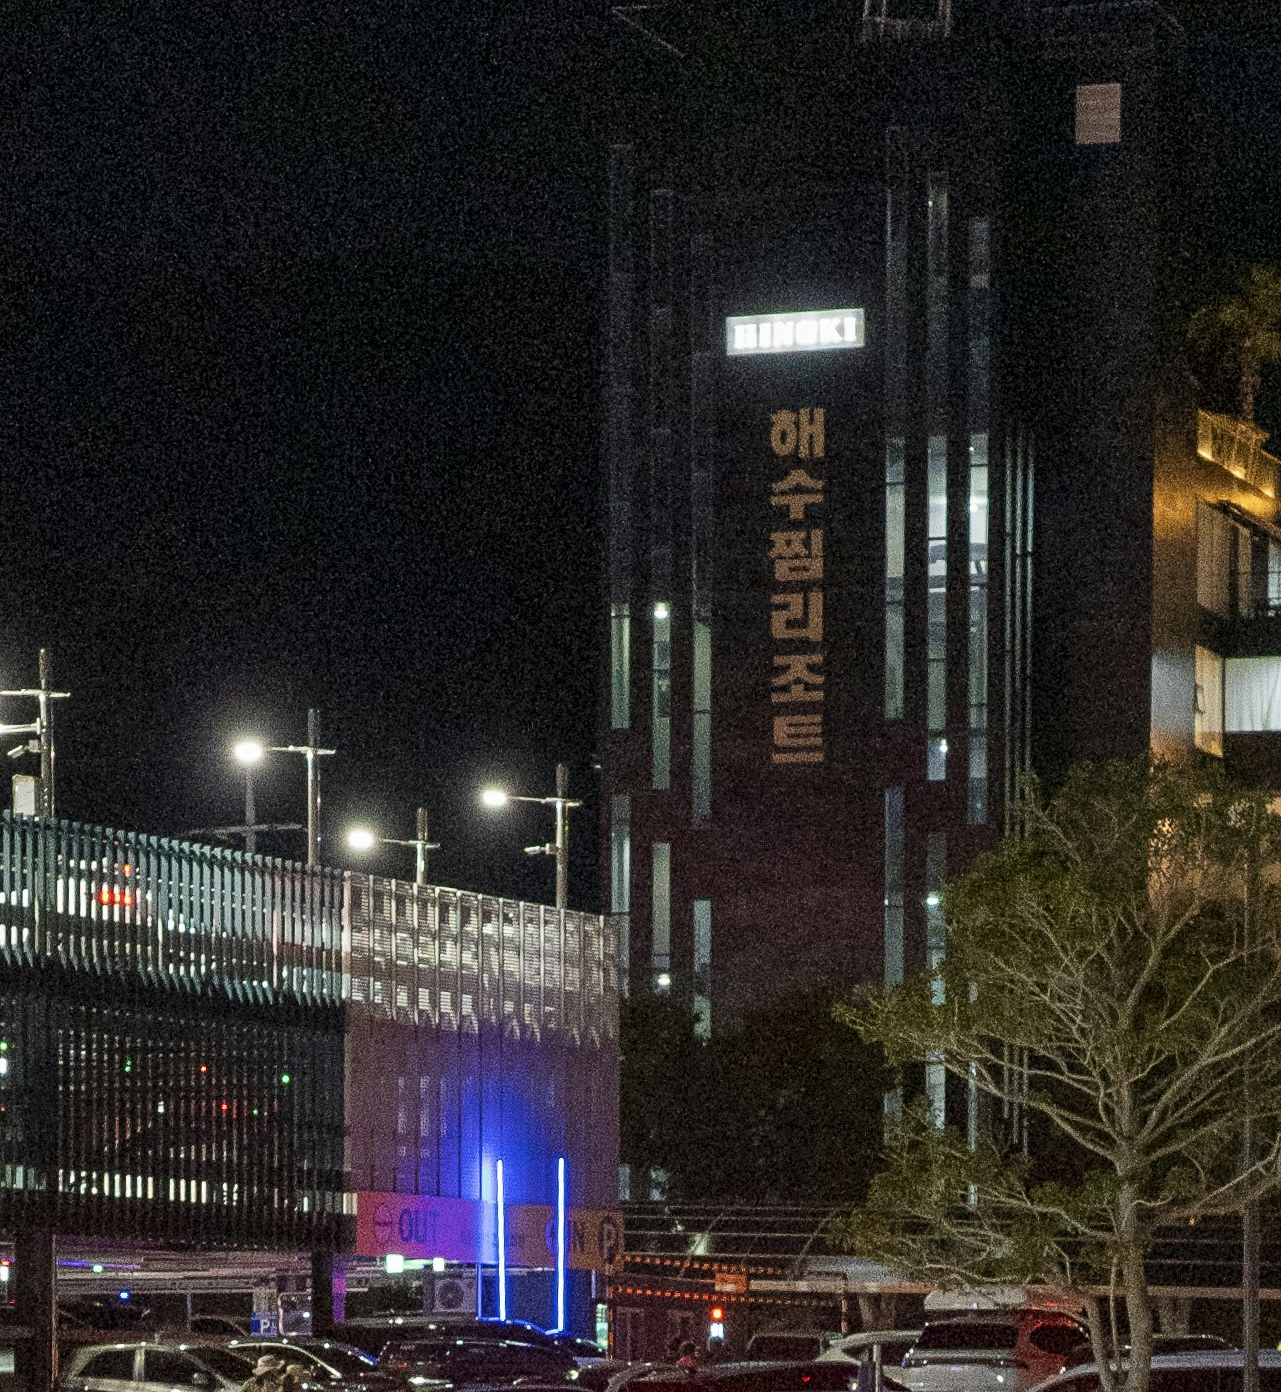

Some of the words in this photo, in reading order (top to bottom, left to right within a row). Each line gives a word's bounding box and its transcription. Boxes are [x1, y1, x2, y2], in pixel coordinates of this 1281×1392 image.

[734, 316, 857, 350] HINOKI
[769, 407, 825, 764] 해수찜리조트
[398, 1208, 440, 1245] OUT
